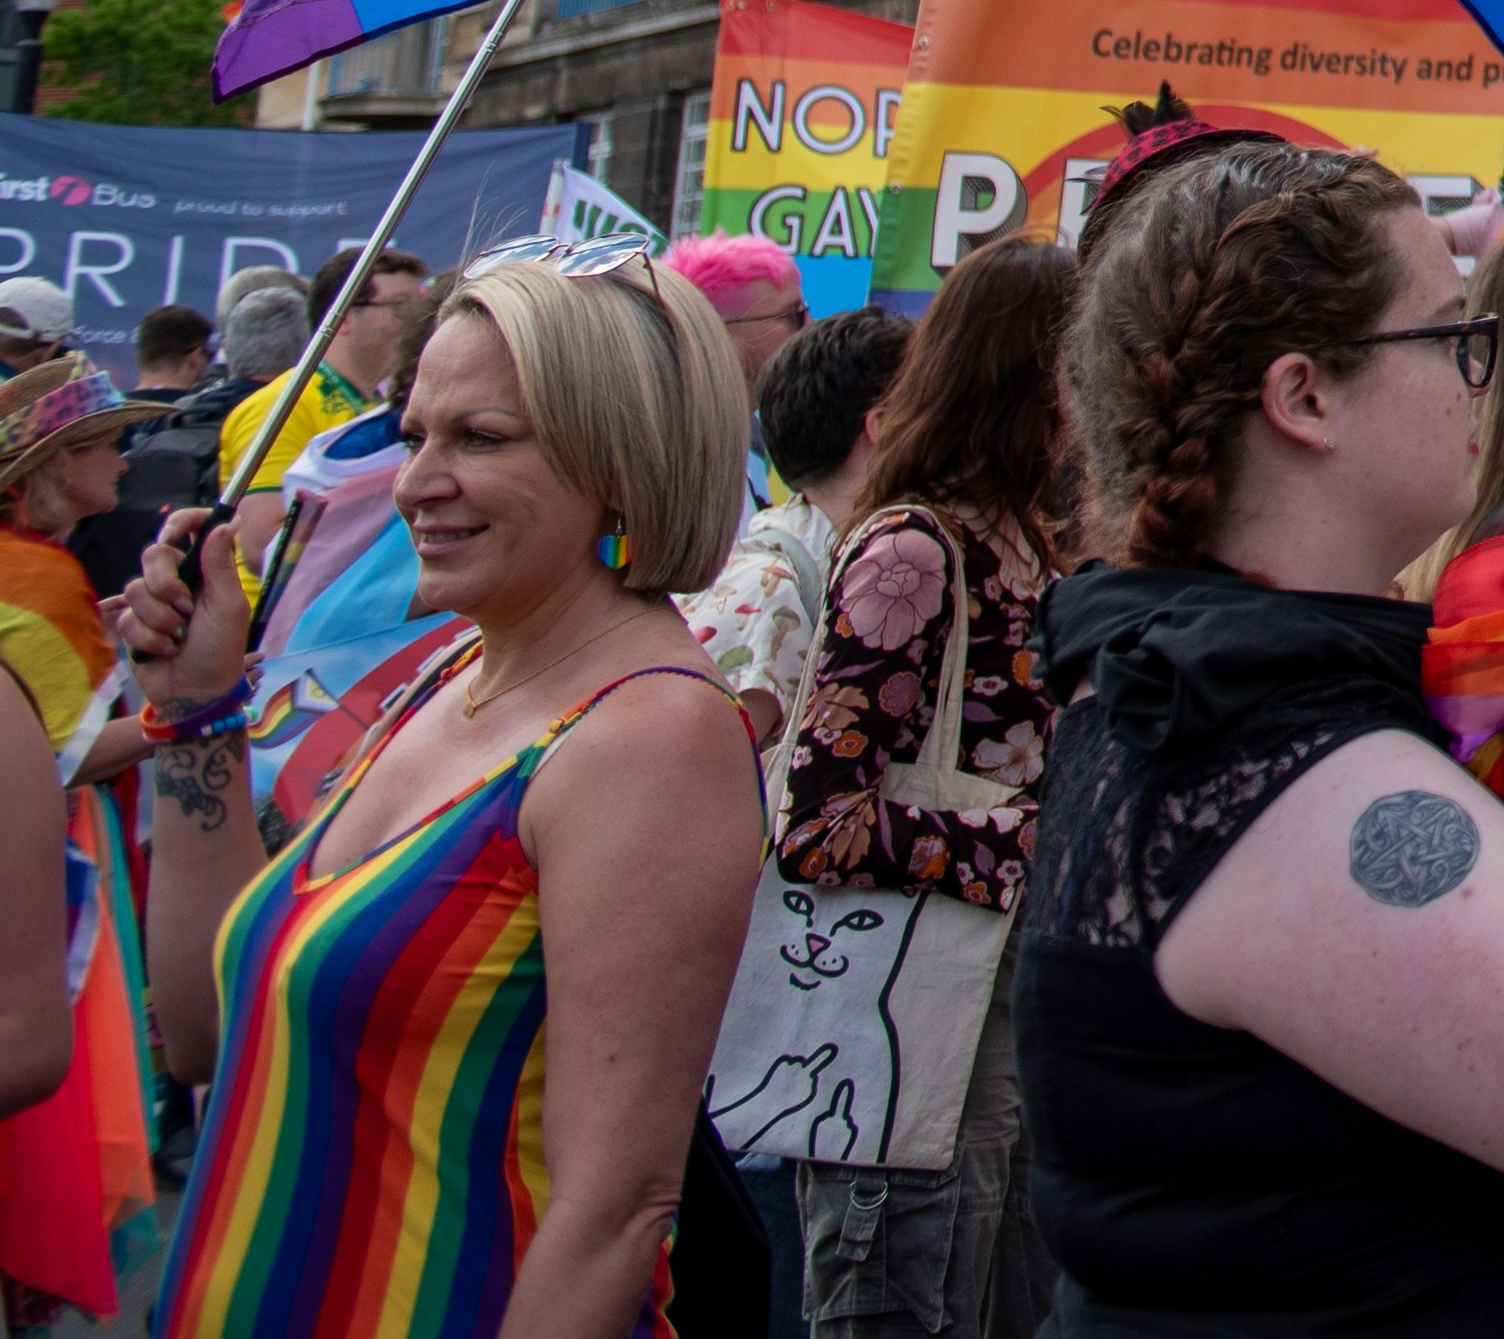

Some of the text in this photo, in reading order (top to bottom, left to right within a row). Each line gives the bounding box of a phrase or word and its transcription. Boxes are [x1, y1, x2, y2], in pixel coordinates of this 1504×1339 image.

[1092, 28, 1273, 75] Celebrating
[1279, 41, 1407, 85] diversity
[1416, 55, 1474, 83] and
[0, 178, 156, 209] irst Bus
[267, 200, 348, 219] support
